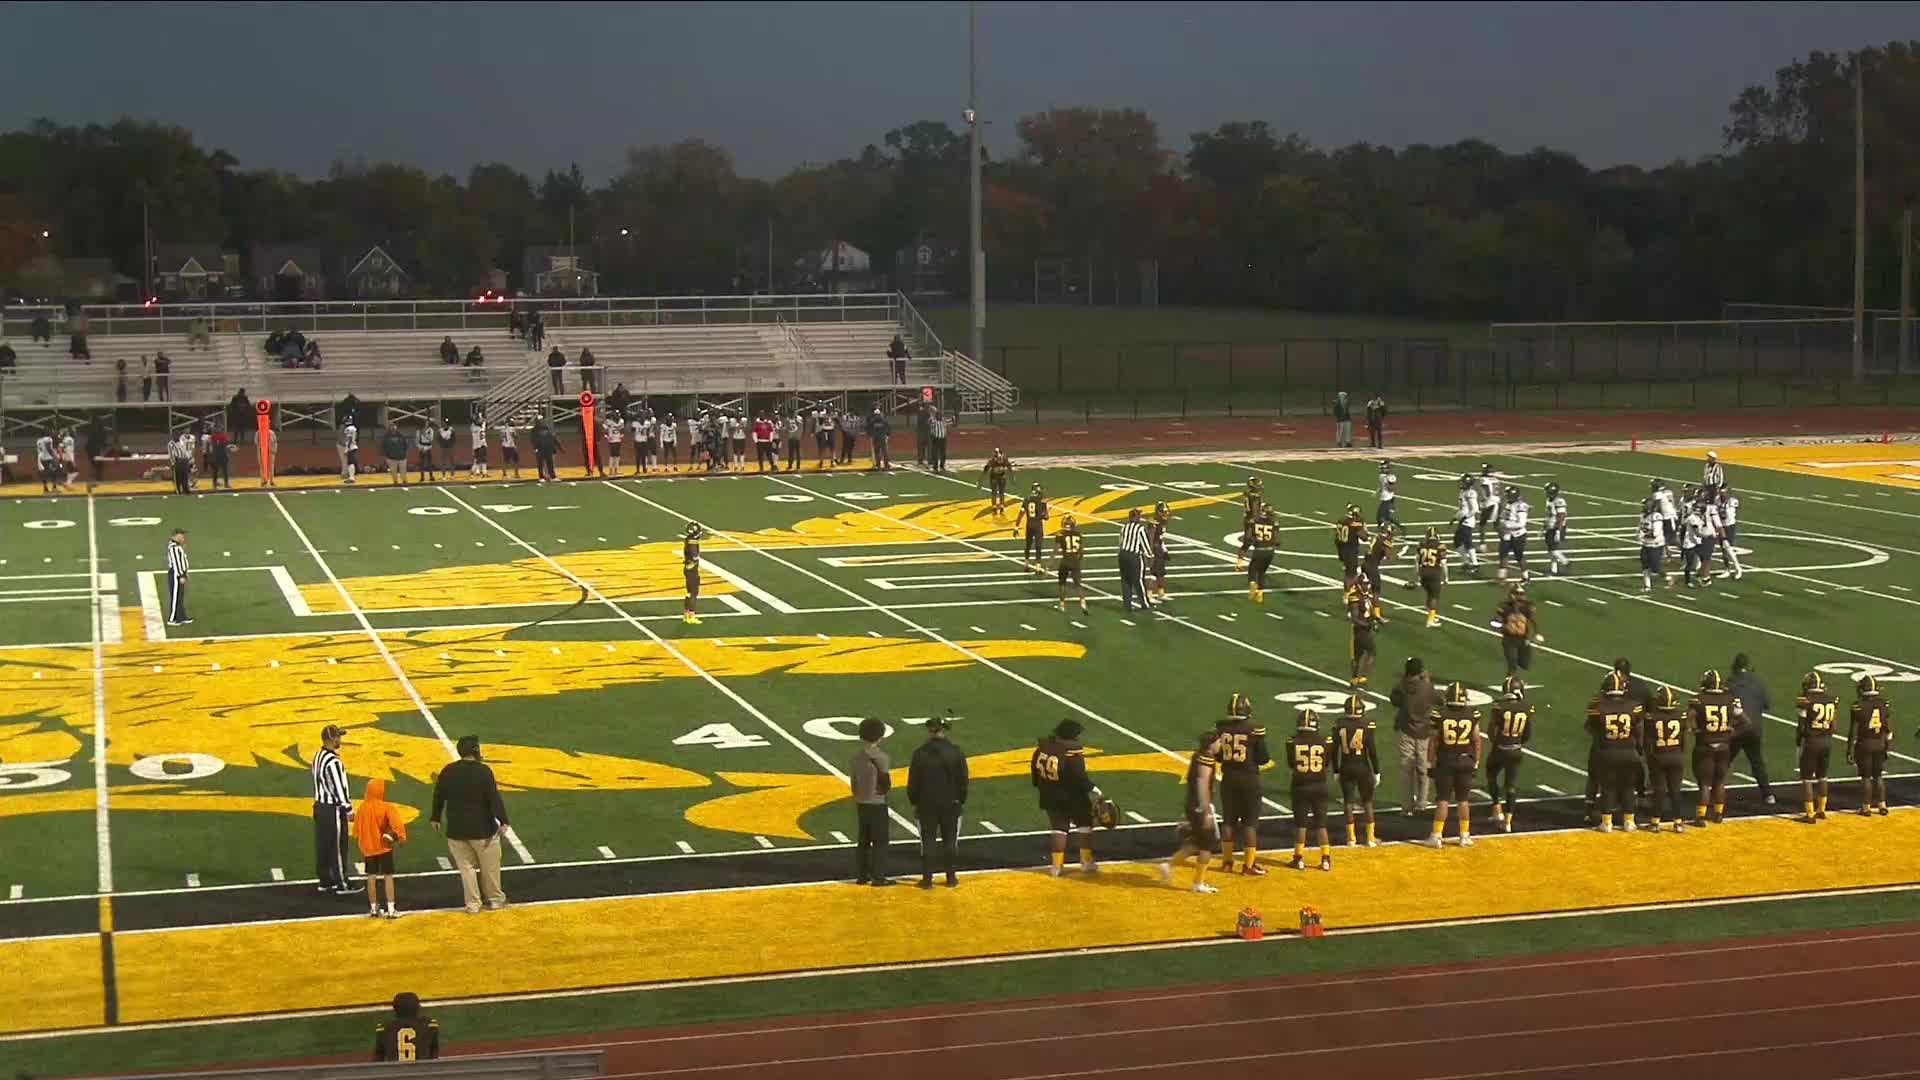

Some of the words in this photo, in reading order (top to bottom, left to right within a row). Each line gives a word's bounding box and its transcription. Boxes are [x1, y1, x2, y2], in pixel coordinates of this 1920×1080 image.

[1064, 535, 1080, 553] 15
[1254, 523, 1273, 541] 55
[1420, 548, 1437, 567] 25
[1503, 711, 1526, 737] 10
[1605, 714, 1631, 740] 53
[1704, 705, 1728, 732] 51
[1812, 703, 1835, 730] 20
[1868, 708, 1882, 734] 4
[1338, 727, 1364, 755] 14
[1442, 719, 1471, 746] 62
[1655, 720, 1680, 747] 12
[1221, 732, 1248, 763] 65
[1295, 744, 1325, 775] 56
[1036, 751, 1059, 782] 59
[397, 1027, 417, 1064] 6
